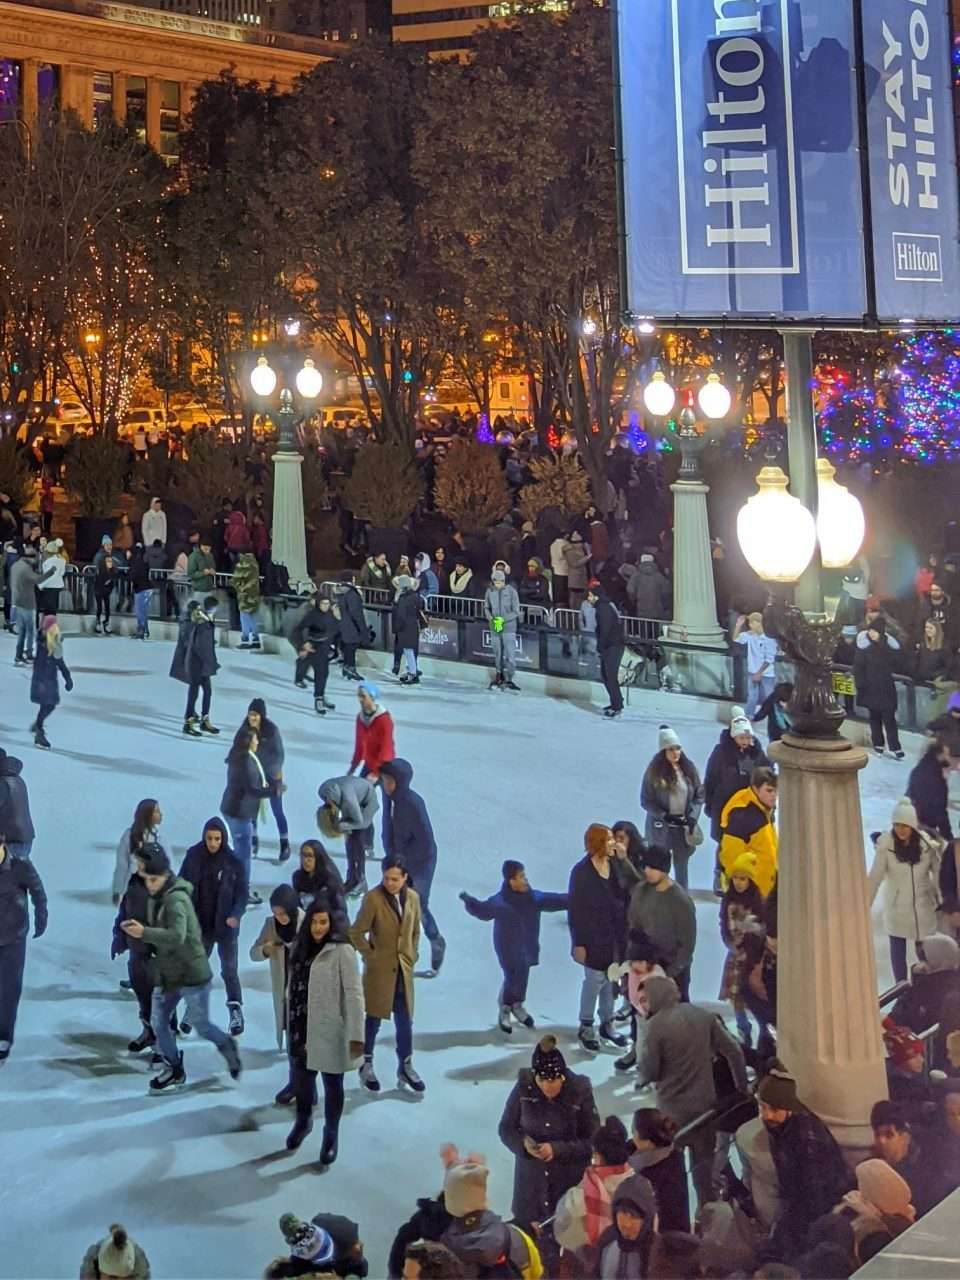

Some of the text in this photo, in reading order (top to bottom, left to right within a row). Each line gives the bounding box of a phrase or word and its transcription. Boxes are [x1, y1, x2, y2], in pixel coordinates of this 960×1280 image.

[882, 20, 909, 208] STAY
[897, 243, 938, 272] Hilton
[834, 680, 852, 693] ICE
